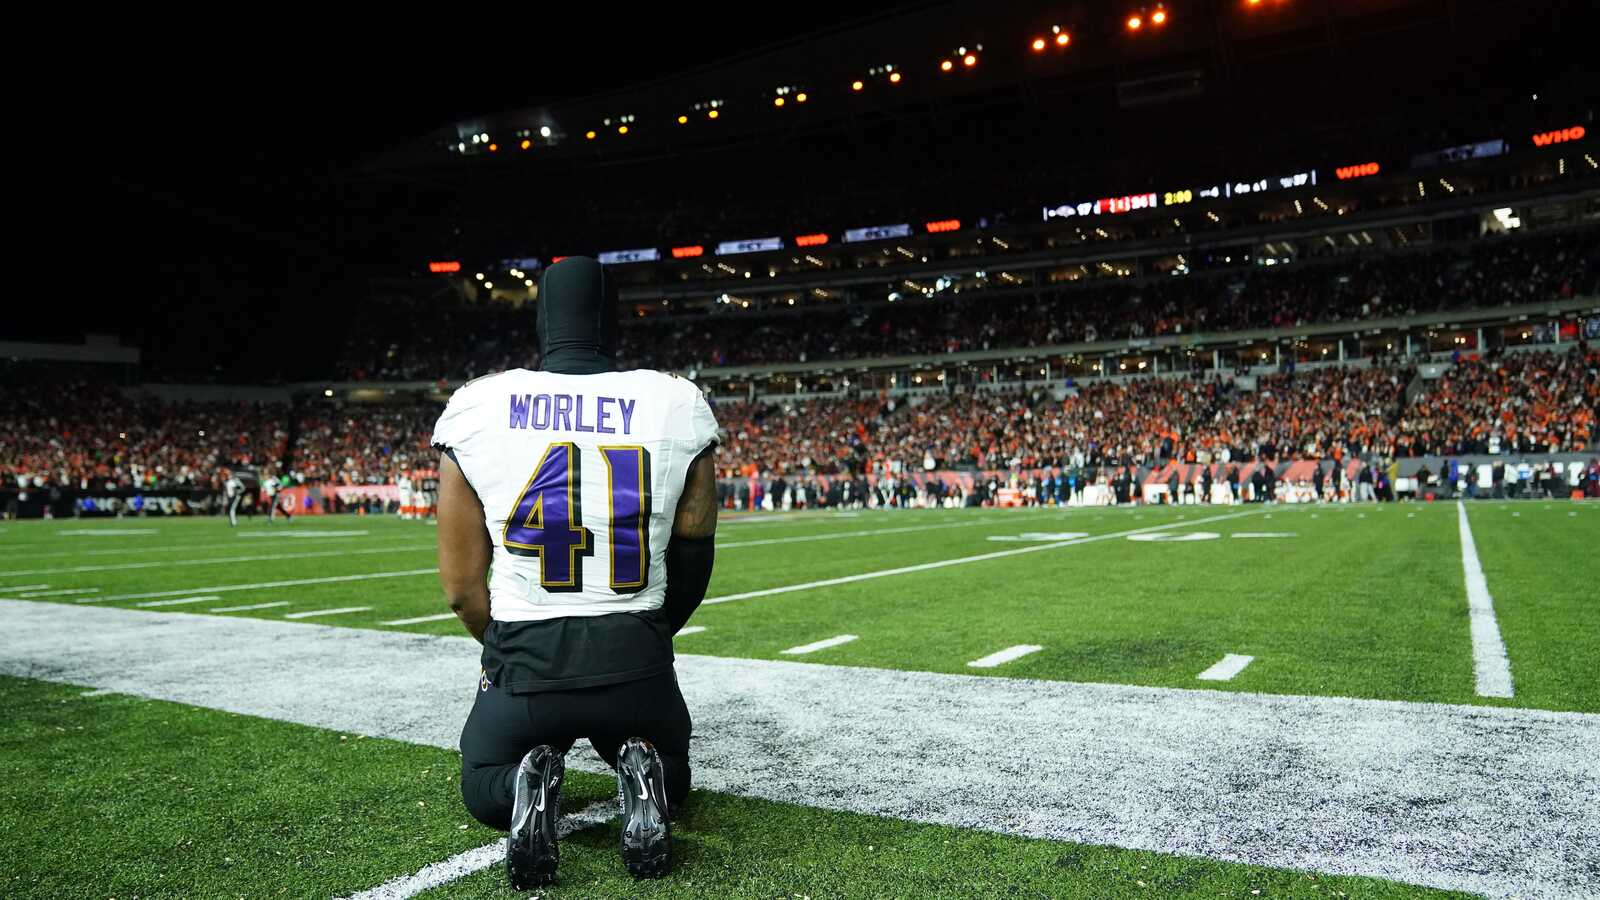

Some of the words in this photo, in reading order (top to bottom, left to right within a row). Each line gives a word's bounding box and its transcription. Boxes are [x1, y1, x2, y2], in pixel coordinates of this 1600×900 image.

[1532, 126, 1586, 146] WHO
[1336, 162, 1380, 179] WHO
[1164, 190, 1192, 205] 2:00
[926, 220, 960, 233] WHO
[509, 394, 636, 435] WORLEY
[503, 441, 651, 595] 41
